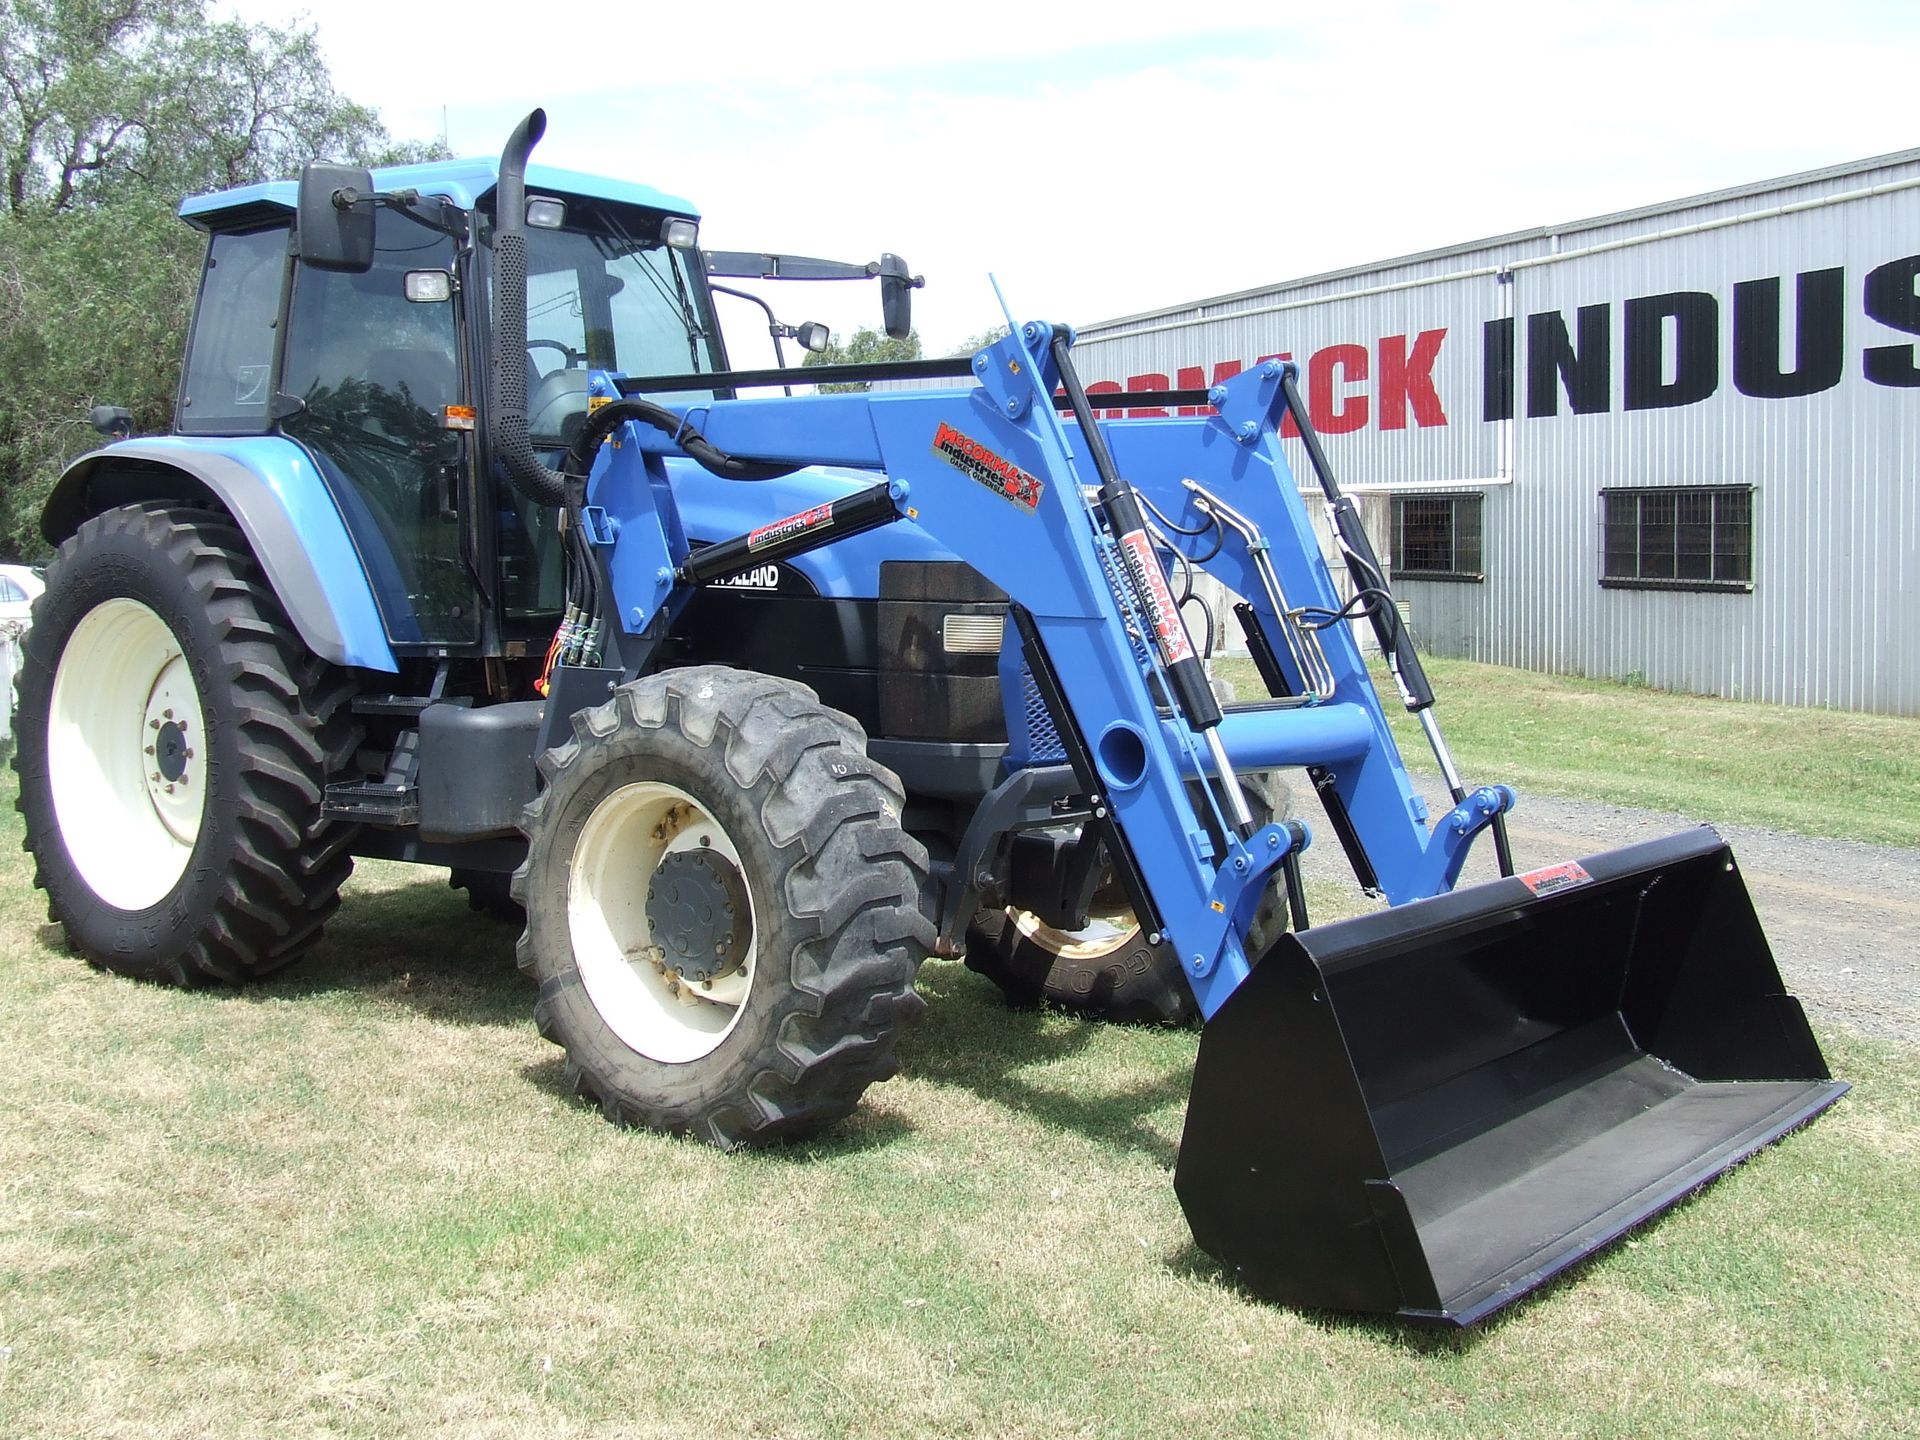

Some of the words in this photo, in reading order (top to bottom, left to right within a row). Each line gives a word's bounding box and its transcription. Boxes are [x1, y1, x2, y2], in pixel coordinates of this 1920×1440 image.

[940, 442, 1006, 488] industries
[972, 470, 1015, 502] QUEENSLAND
[754, 519, 805, 545] industries
[714, 565, 779, 587] LLAND
[1125, 543, 1164, 624] industries
